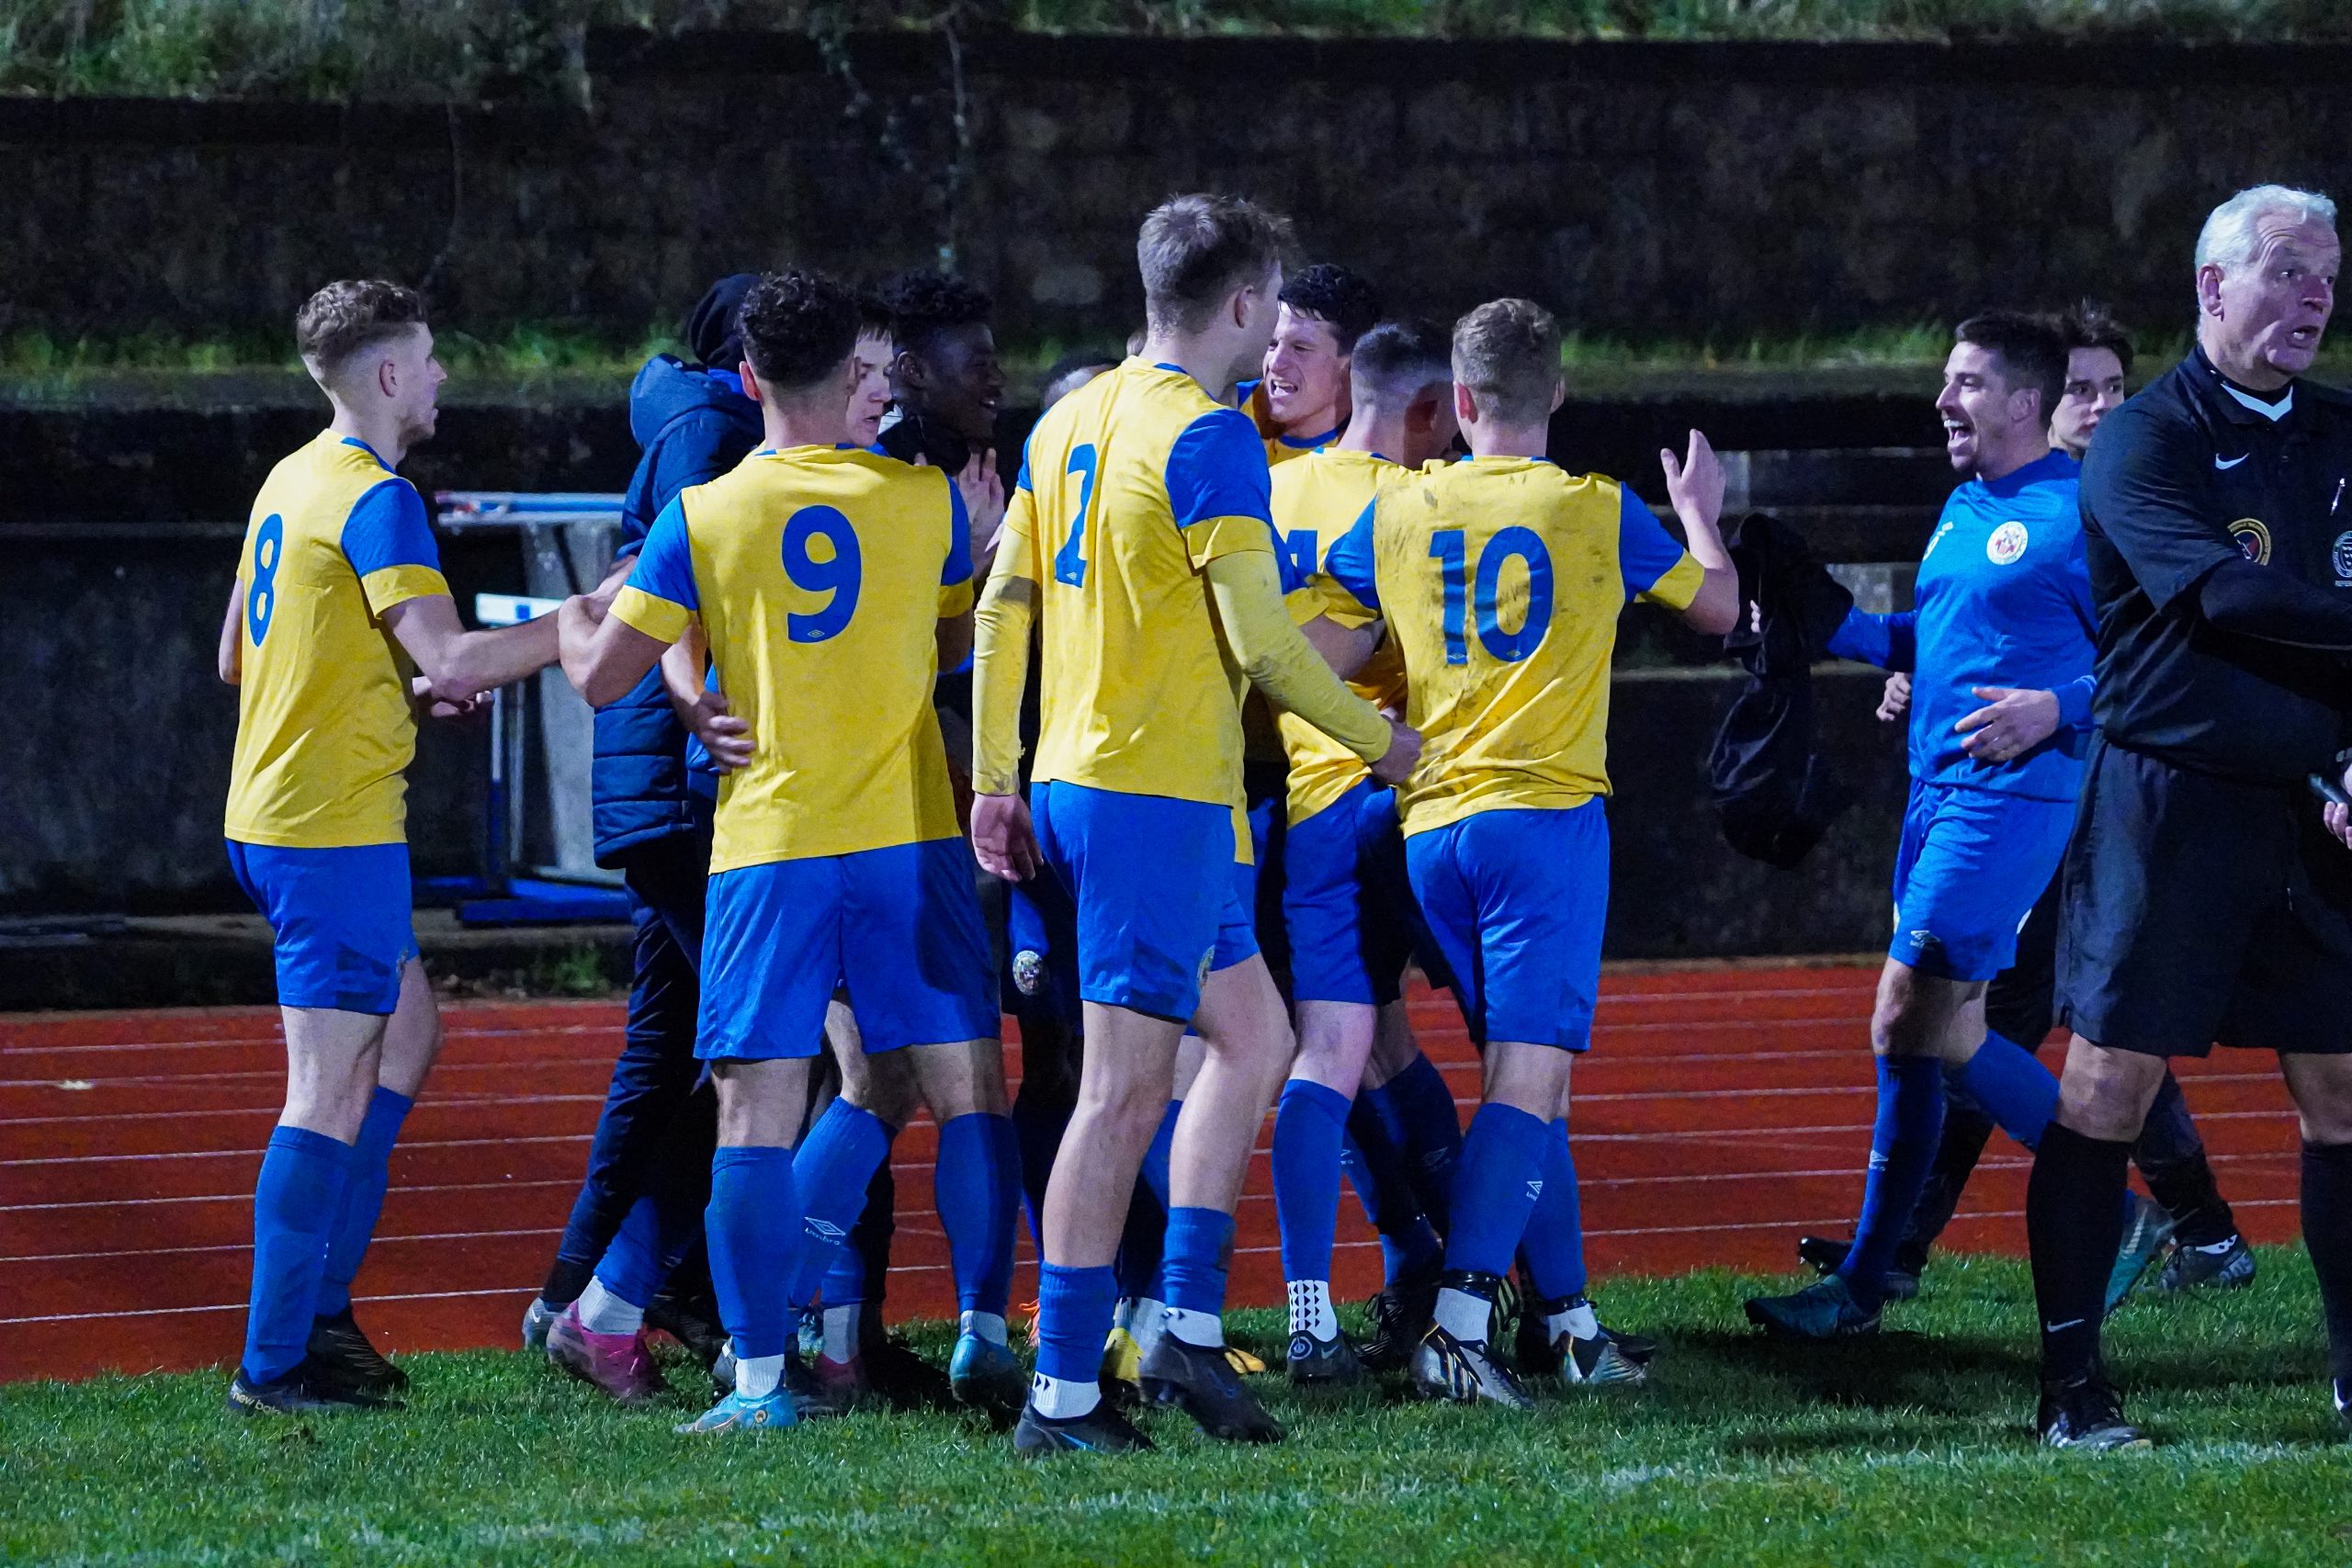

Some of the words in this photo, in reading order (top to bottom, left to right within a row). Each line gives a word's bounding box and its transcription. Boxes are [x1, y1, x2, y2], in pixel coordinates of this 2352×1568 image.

[246, 513, 284, 648] 8
[782, 505, 862, 643] 9
[1429, 525, 1554, 665] 10
